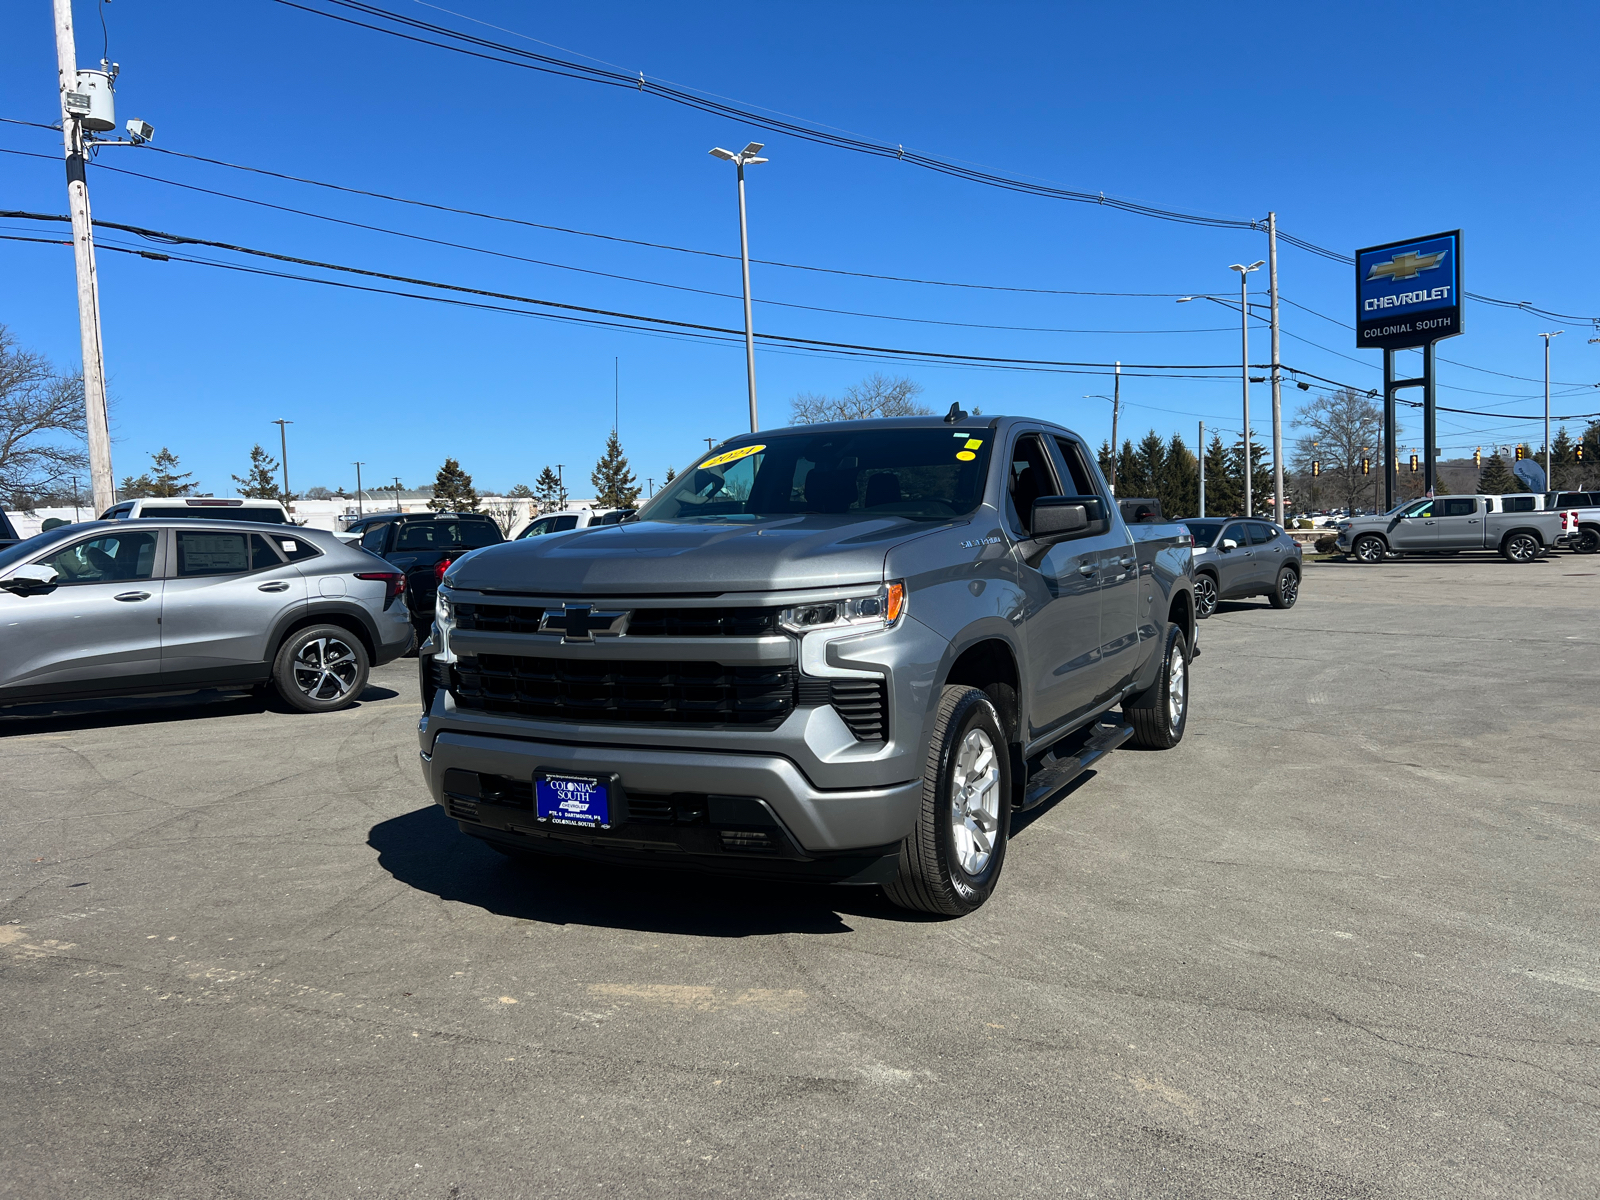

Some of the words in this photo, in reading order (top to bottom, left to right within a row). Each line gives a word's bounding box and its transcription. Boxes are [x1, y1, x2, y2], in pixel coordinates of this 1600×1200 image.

[1365, 286, 1450, 311] CHEVROLET
[1364, 324, 1412, 338] COLONIAL
[1416, 317, 1451, 330] SOUTH
[707, 446, 756, 467] 2024
[550, 780, 597, 793] COLONIAL
[557, 790, 589, 801] SOUTH
[562, 802, 587, 810] CHEVROLET
[552, 818, 577, 826] COLONIAL
[578, 820, 595, 828] SOUTH
